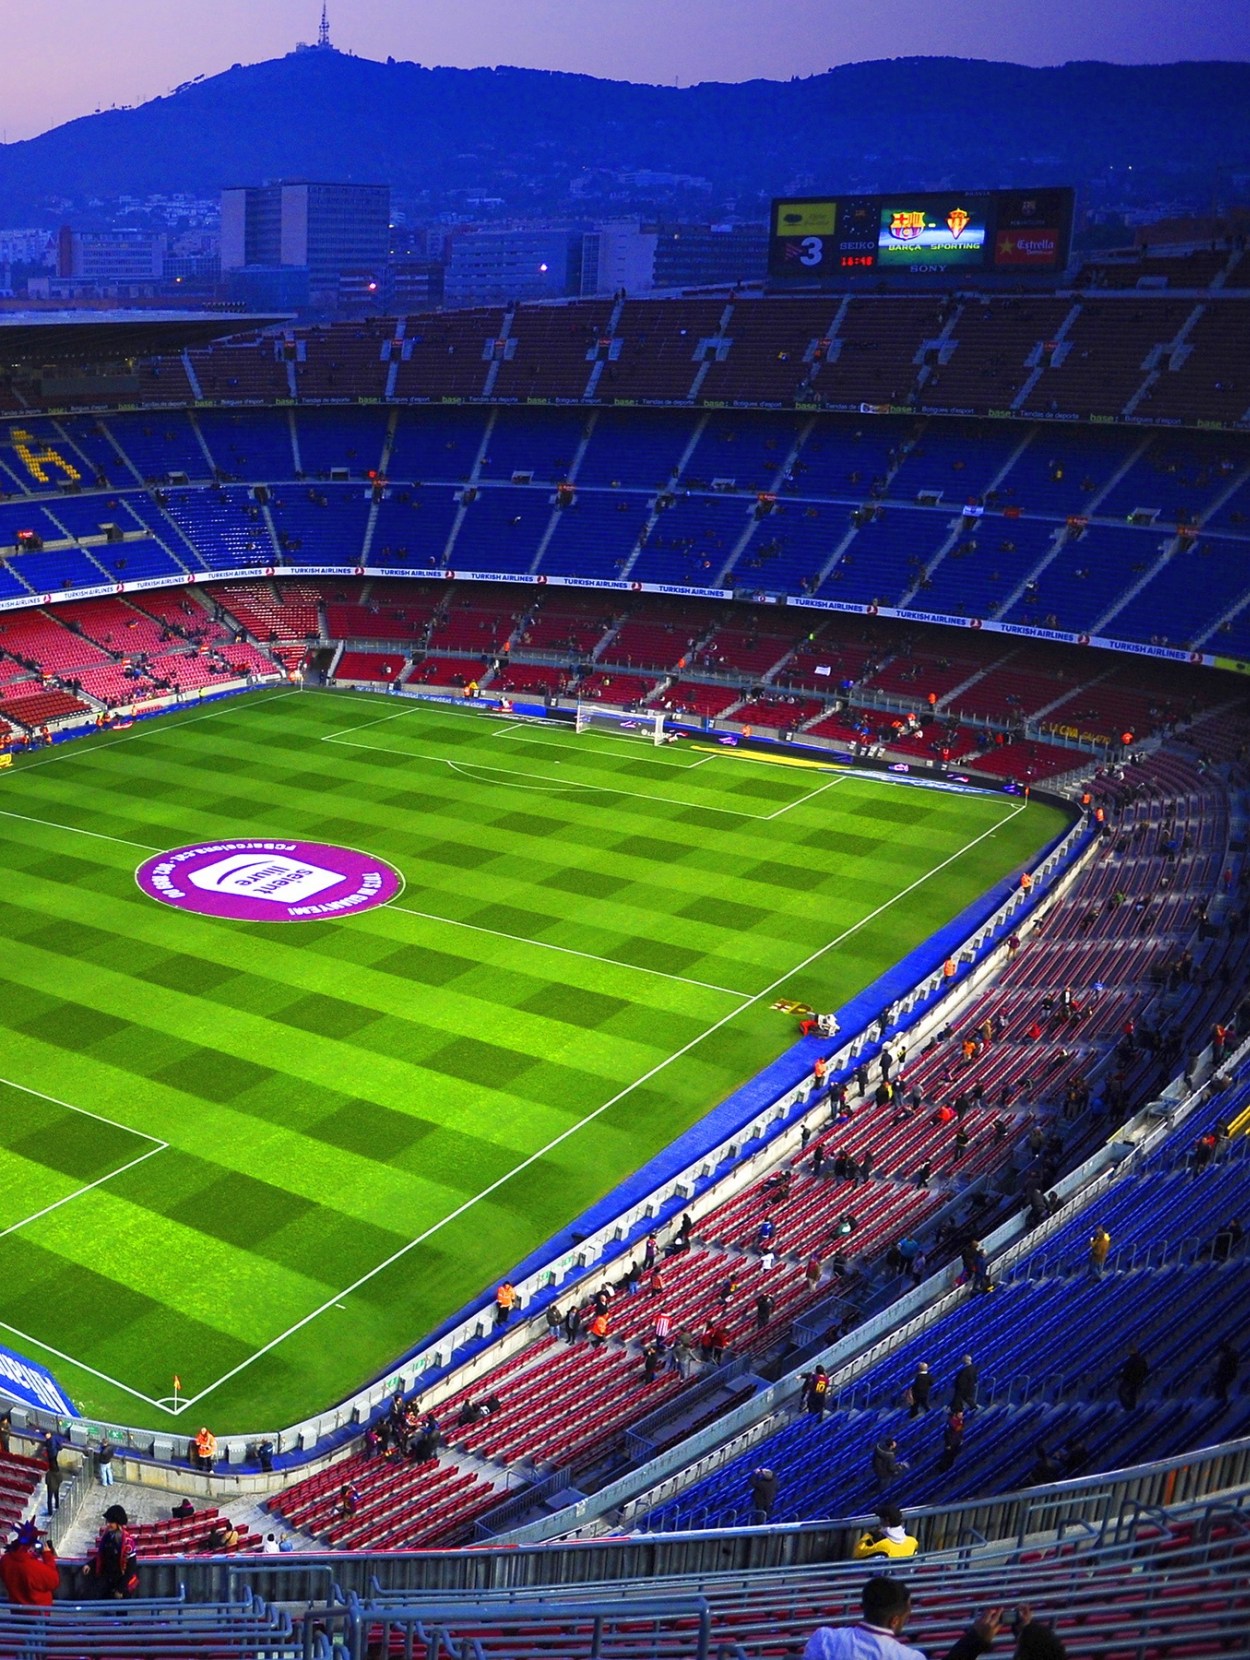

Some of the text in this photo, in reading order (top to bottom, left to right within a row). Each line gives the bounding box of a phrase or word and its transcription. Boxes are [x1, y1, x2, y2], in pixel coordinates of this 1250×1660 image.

[839, 242, 875, 250] SEIKO
[930, 242, 980, 250] SPORTING
[1017, 239, 1054, 250] Estrella
[800, 236, 823, 266] 3
[910, 264, 947, 273] SONY
[208, 569, 262, 580] TURKISH AIRLINES
[471, 572, 533, 582] TURKISH AIRLINES
[137, 577, 185, 589] TURKISH AIRLINES
[564, 578, 627, 589] TURKISH AIRLINES
[64, 586, 113, 599] TURKISH AIRLINES
[659, 585, 724, 597] TURKISH AIRLINES
[16, 597, 40, 607] AIRLINES
[795, 598, 862, 612] TURKISH AIRLINES
[896, 610, 966, 626] TURKISH AIRLINES
[1001, 624, 1073, 642] TURKISH AIRLINES
[1109, 640, 1186, 660] TURKISH AIRLINES
[234, 865, 291, 887] lliure
[815, 1382, 826, 1393] 10
